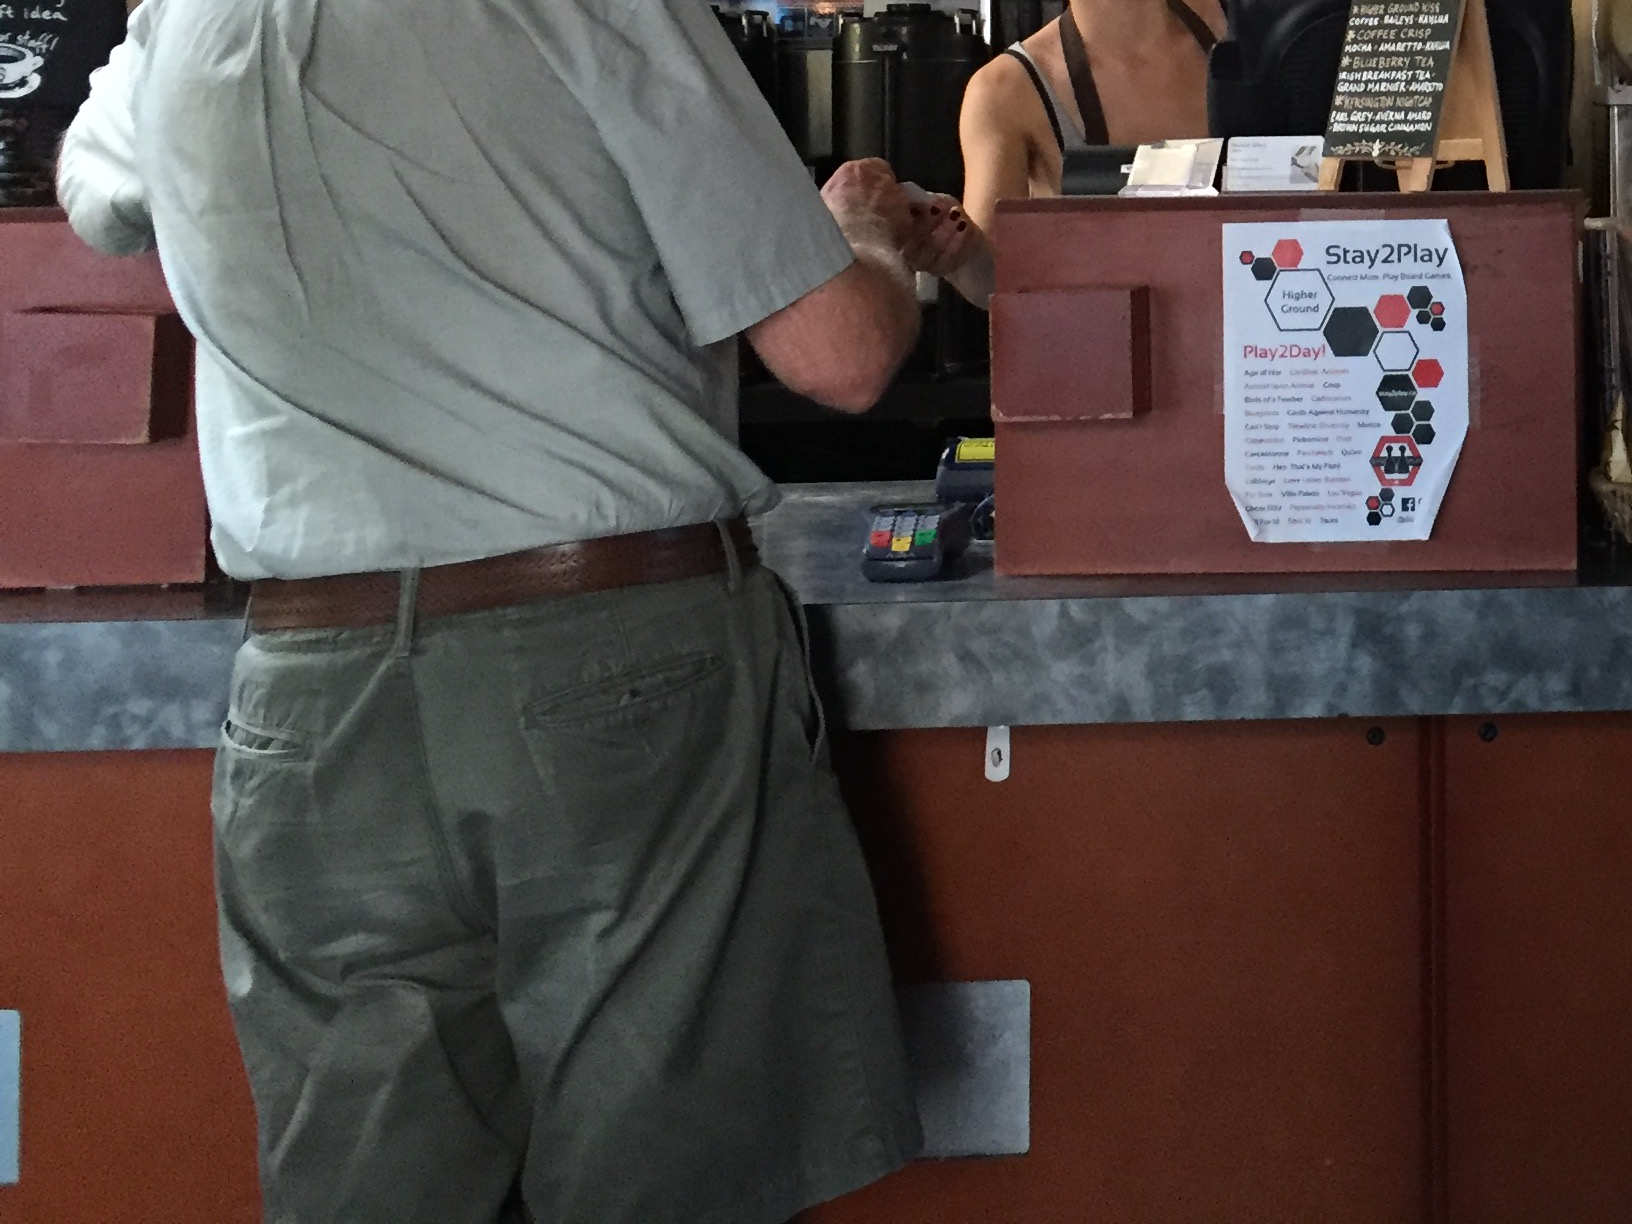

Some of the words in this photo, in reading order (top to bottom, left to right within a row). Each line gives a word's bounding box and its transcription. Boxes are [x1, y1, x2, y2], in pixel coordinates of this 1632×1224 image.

[24, 6, 68, 21] idea
[1357, 29, 1397, 40] COFFEE
[1400, 28, 1431, 38] CRISP
[1415, 56, 1434, 67] TEA
[1415, 71, 1430, 79] TEA
[1325, 243, 1449, 268] Stay2Play
[1283, 290, 1318, 302] Higher
[1281, 304, 1319, 313] Ground
[1243, 344, 1325, 361] Play2Day!
